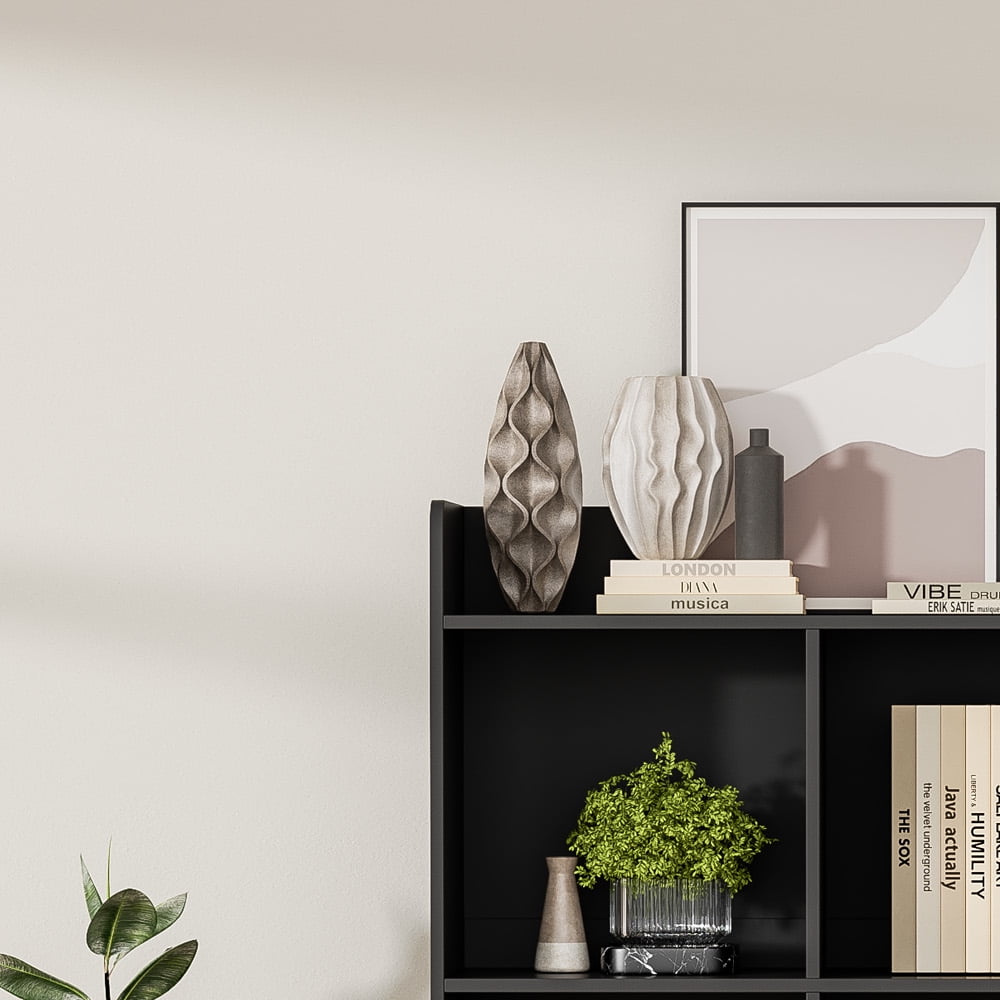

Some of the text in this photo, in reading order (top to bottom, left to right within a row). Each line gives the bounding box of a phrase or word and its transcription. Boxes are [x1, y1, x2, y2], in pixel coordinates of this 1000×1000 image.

[662, 562, 736, 576] LONDON
[681, 582, 717, 593] DIANA
[904, 584, 961, 599] VIBE
[672, 597, 728, 609] musica
[929, 602, 947, 612] ERIK
[951, 602, 974, 612] SATIE
[898, 809, 910, 867] THE SOX
[922, 783, 932, 891] the velvet underground
[941, 786, 960, 890] Java actually
[971, 813, 984, 899] HUMILITY
